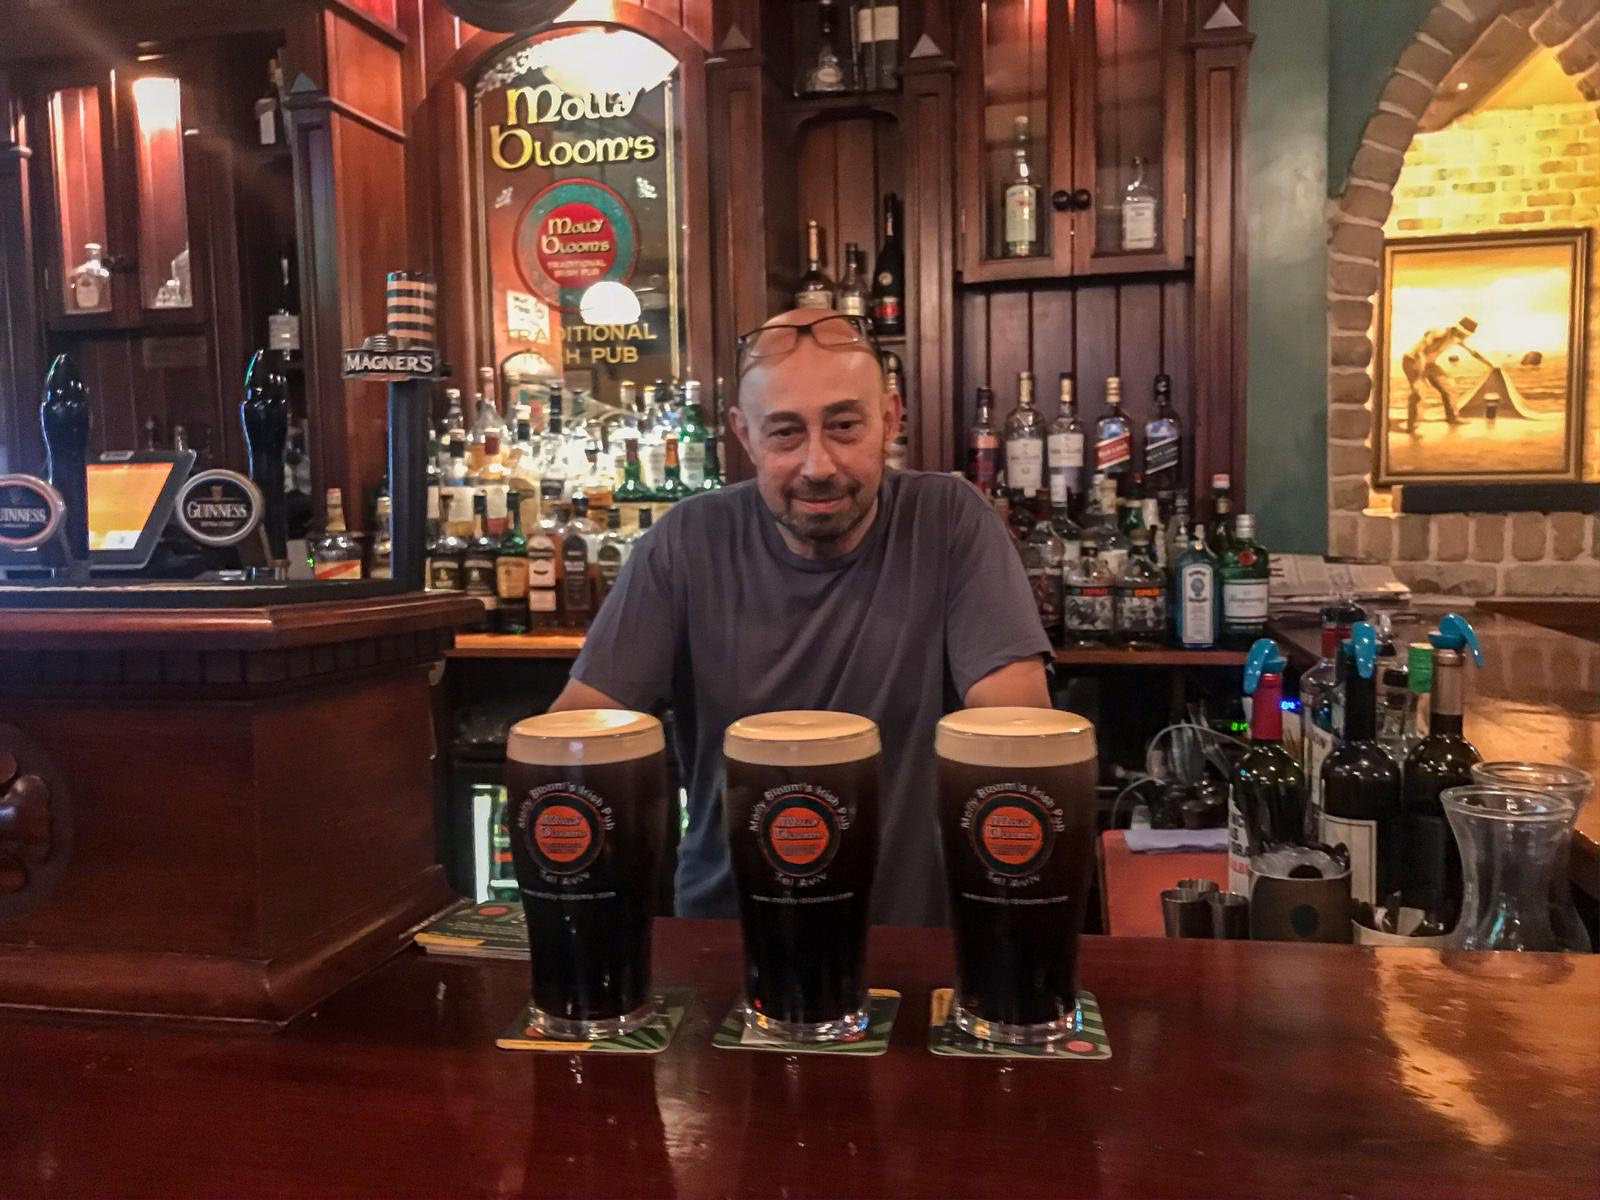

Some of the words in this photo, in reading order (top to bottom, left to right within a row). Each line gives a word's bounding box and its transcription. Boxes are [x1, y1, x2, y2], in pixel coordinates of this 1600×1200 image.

[592, 346, 639, 365] PUB
[0, 507, 46, 522] UINNESS
[187, 501, 248, 519] GUINNESS
